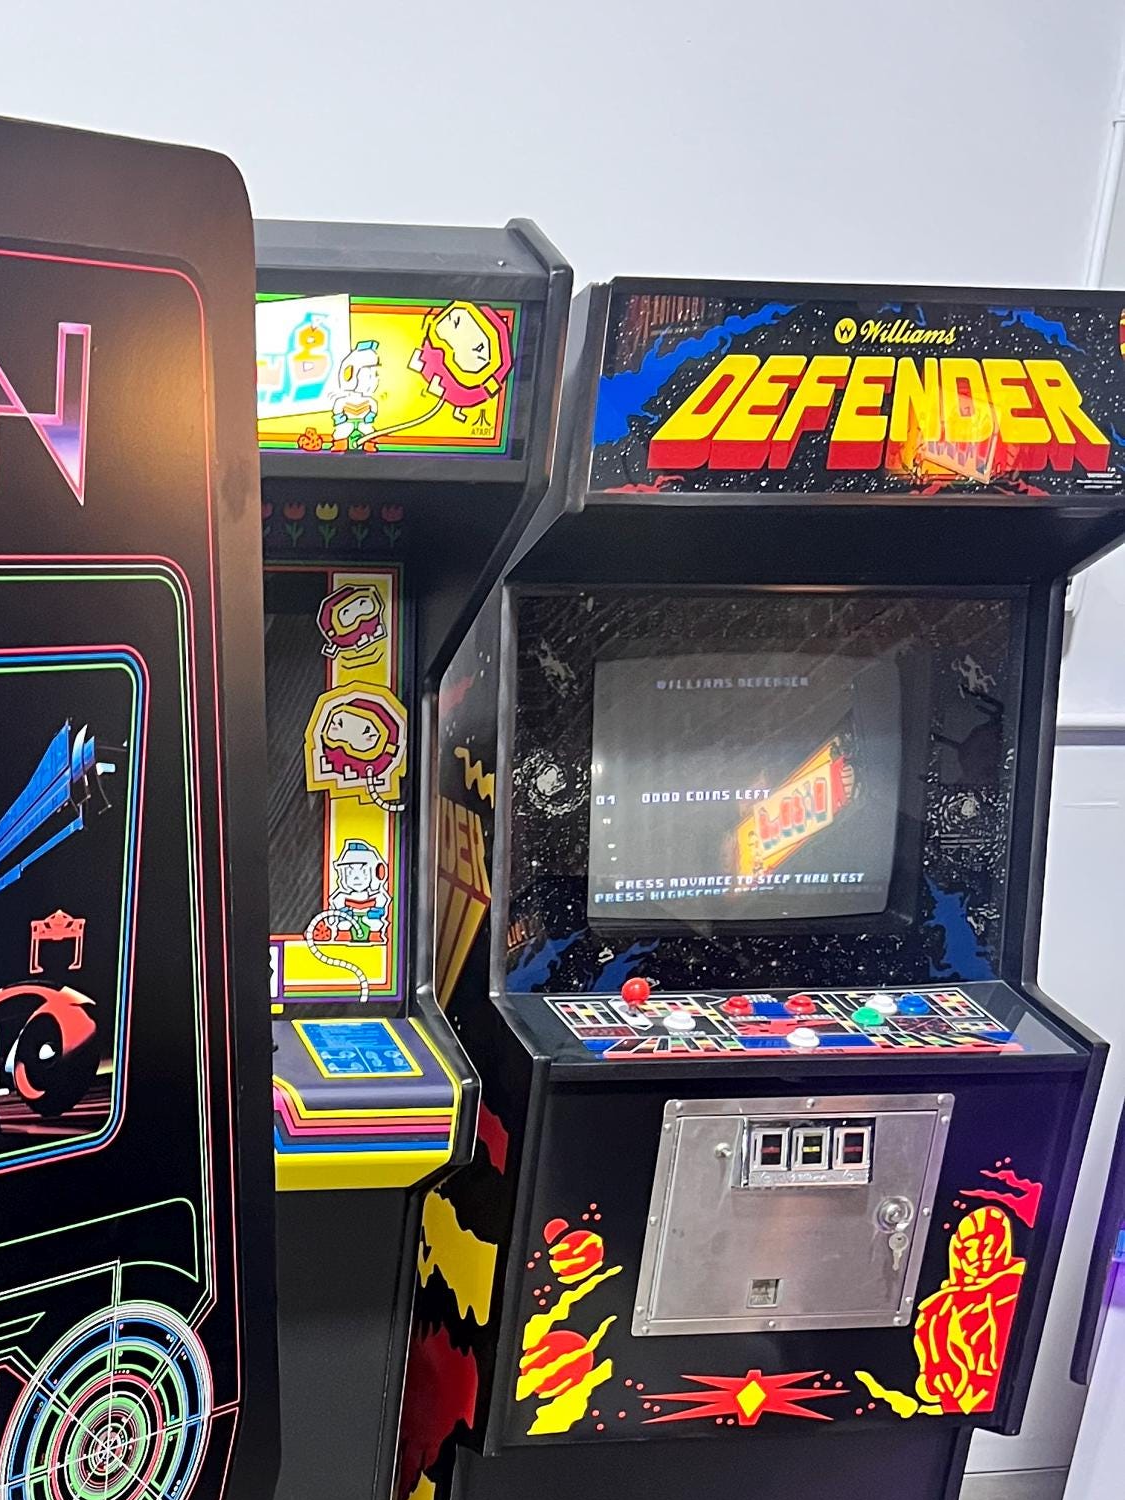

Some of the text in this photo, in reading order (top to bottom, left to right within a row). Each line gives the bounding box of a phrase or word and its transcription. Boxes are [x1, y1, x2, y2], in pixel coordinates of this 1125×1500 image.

[859, 319, 957, 345] Williams
[646, 354, 1111, 470] DEFENDER
[471, 427, 492, 436] ATARI
[686, 790, 730, 802] COINS
[735, 789, 771, 801] LEFT
[615, 873, 865, 890] PRESS ADVANCE TO STEP THRU TEST
[594, 891, 645, 903] PRESS
